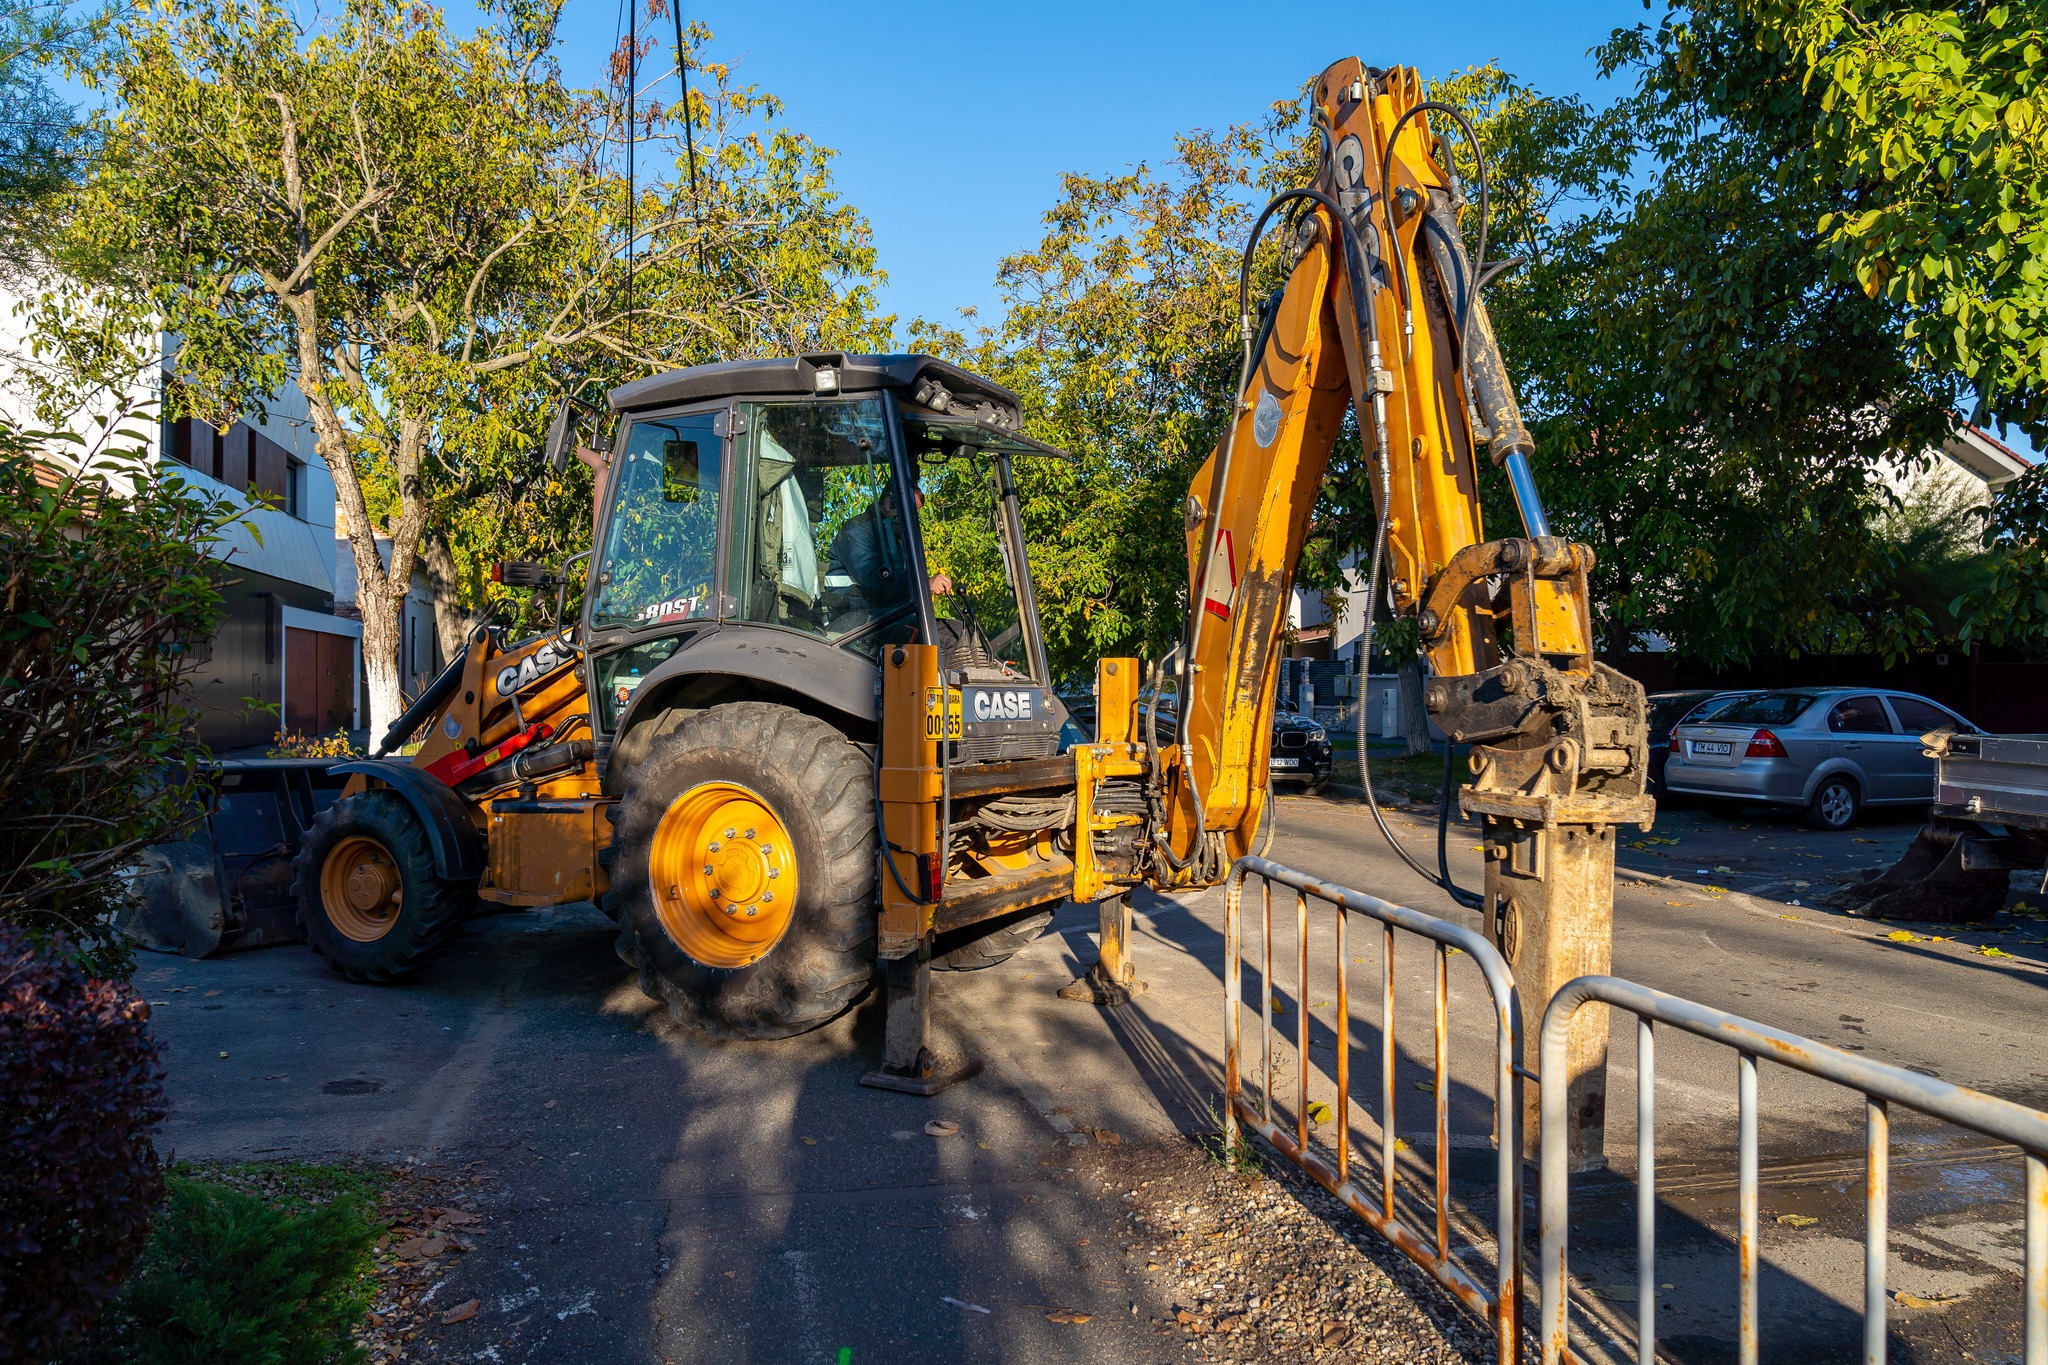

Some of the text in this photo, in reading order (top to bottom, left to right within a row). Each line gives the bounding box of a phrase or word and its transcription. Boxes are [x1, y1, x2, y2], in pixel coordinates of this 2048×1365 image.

[1335, 137, 1386, 297] CAS
[936, 694, 960, 704] TIOARA
[974, 690, 1031, 720] CASE
[927, 714, 960, 735] 0055
[1697, 742, 1706, 751] TM
[1707, 743, 1715, 751] 44
